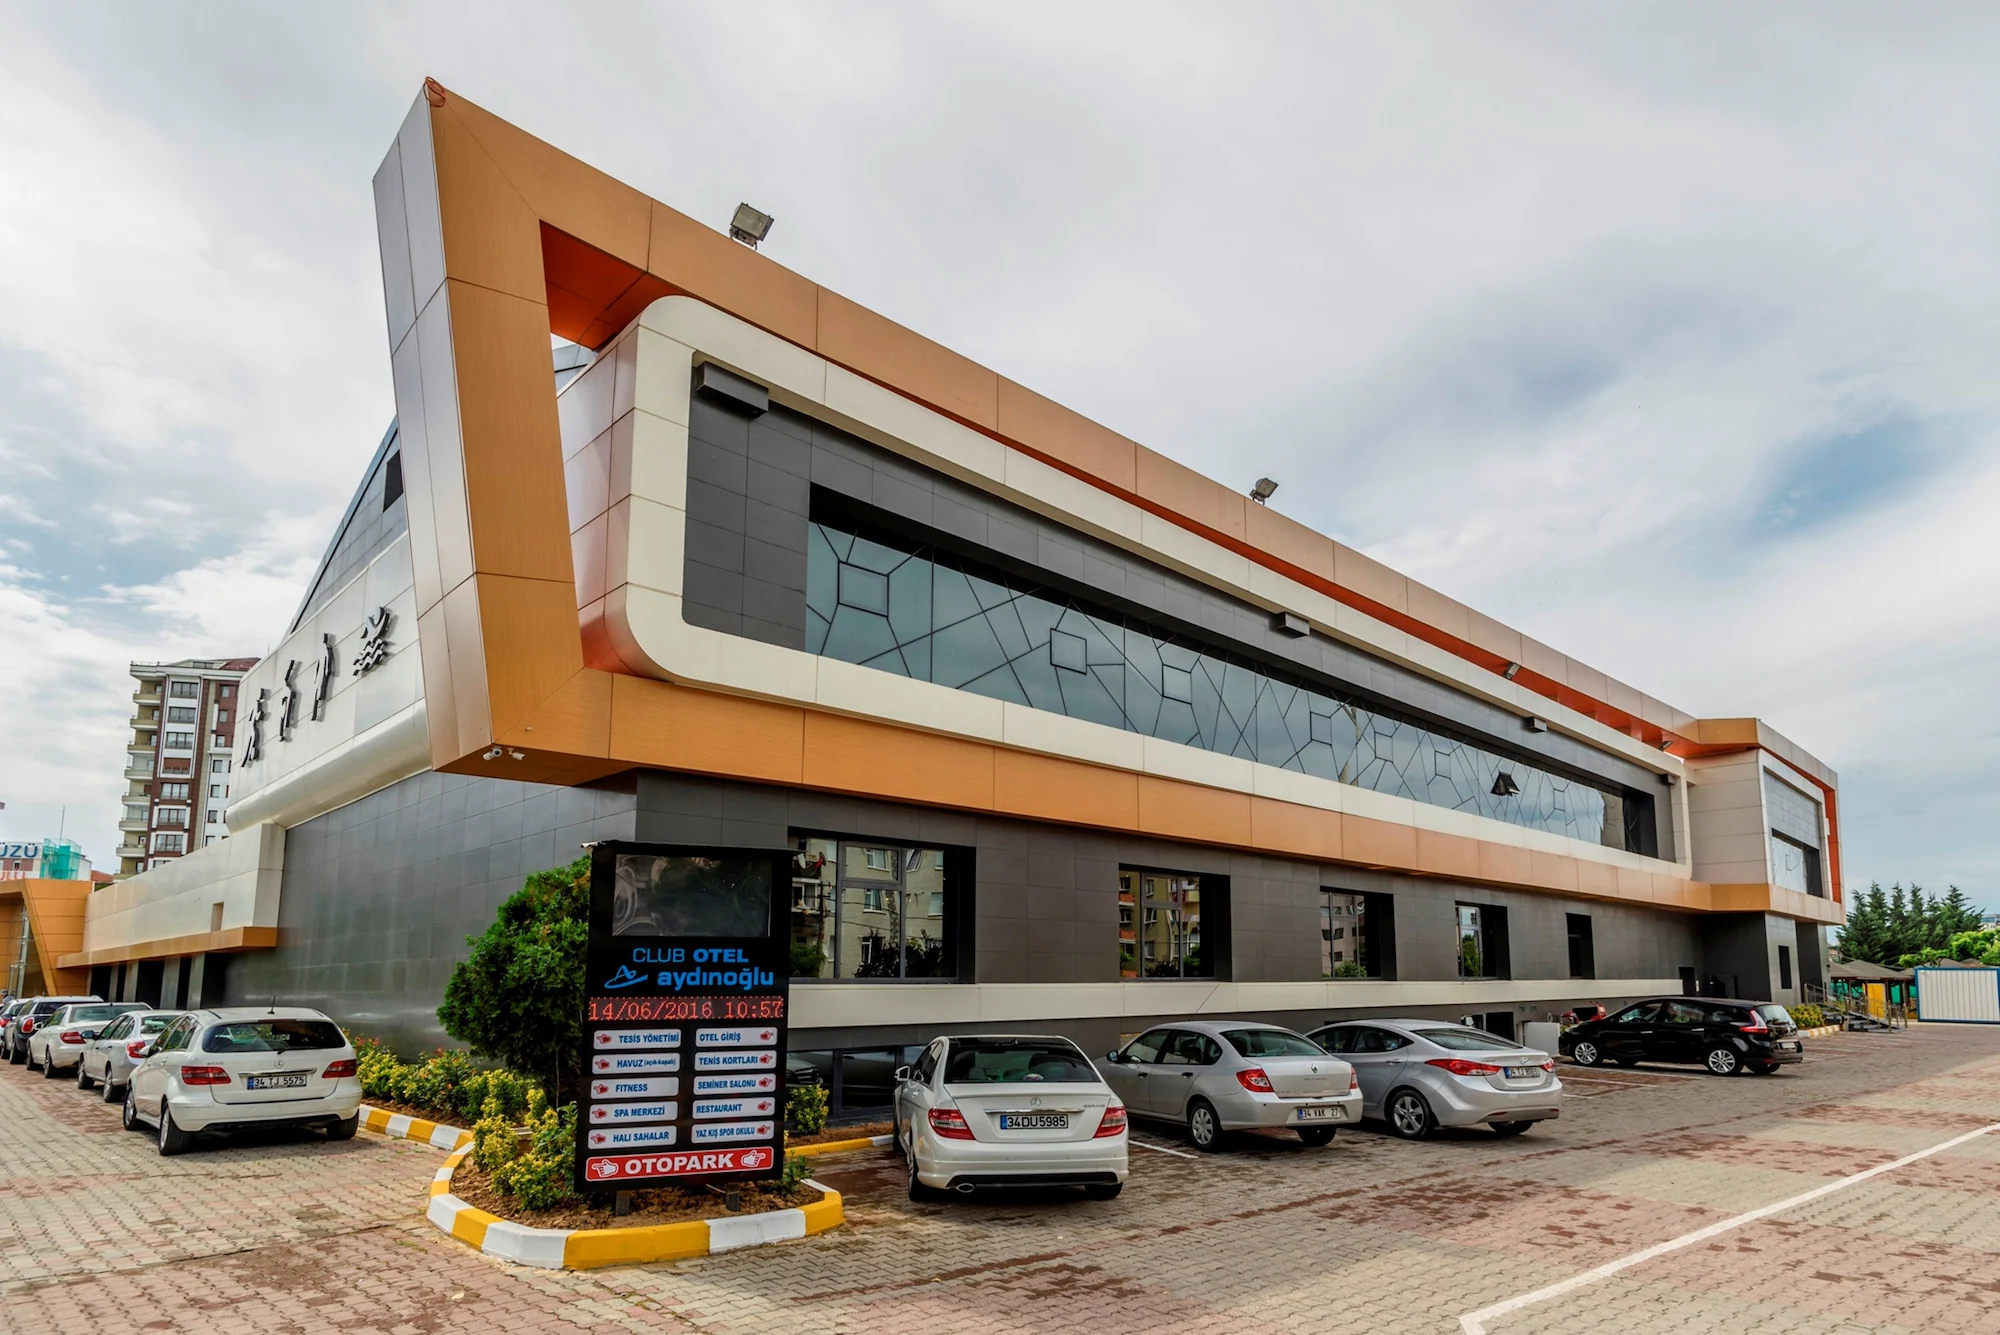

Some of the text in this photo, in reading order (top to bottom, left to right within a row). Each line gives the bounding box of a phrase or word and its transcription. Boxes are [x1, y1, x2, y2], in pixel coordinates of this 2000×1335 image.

[633, 947, 749, 963] CLUB OTEL
[657, 967, 774, 991] aydınoğlu
[589, 1000, 782, 1020] 14/06/2016 10:57
[619, 1034, 641, 1043] TESİS
[699, 1031, 741, 1043] OTEL GİRİŞ
[617, 1059, 643, 1068] HAVUZ
[698, 1055, 758, 1065] TENİS KORTLARI
[254, 1076, 304, 1087] 34 TJ 5575
[729, 1079, 757, 1088] SALONU
[615, 1083, 648, 1092] FITNESS
[614, 1105, 665, 1117] SPA MERKEZİ
[696, 1103, 742, 1113] RESTAURANT
[613, 1131, 669, 1142] HALI SAHALAR
[695, 1129, 707, 1137] YAZ
[719, 1127, 735, 1136] SPOR
[735, 1126, 756, 1135] OKULU
[624, 1153, 734, 1175] OTOPARK
